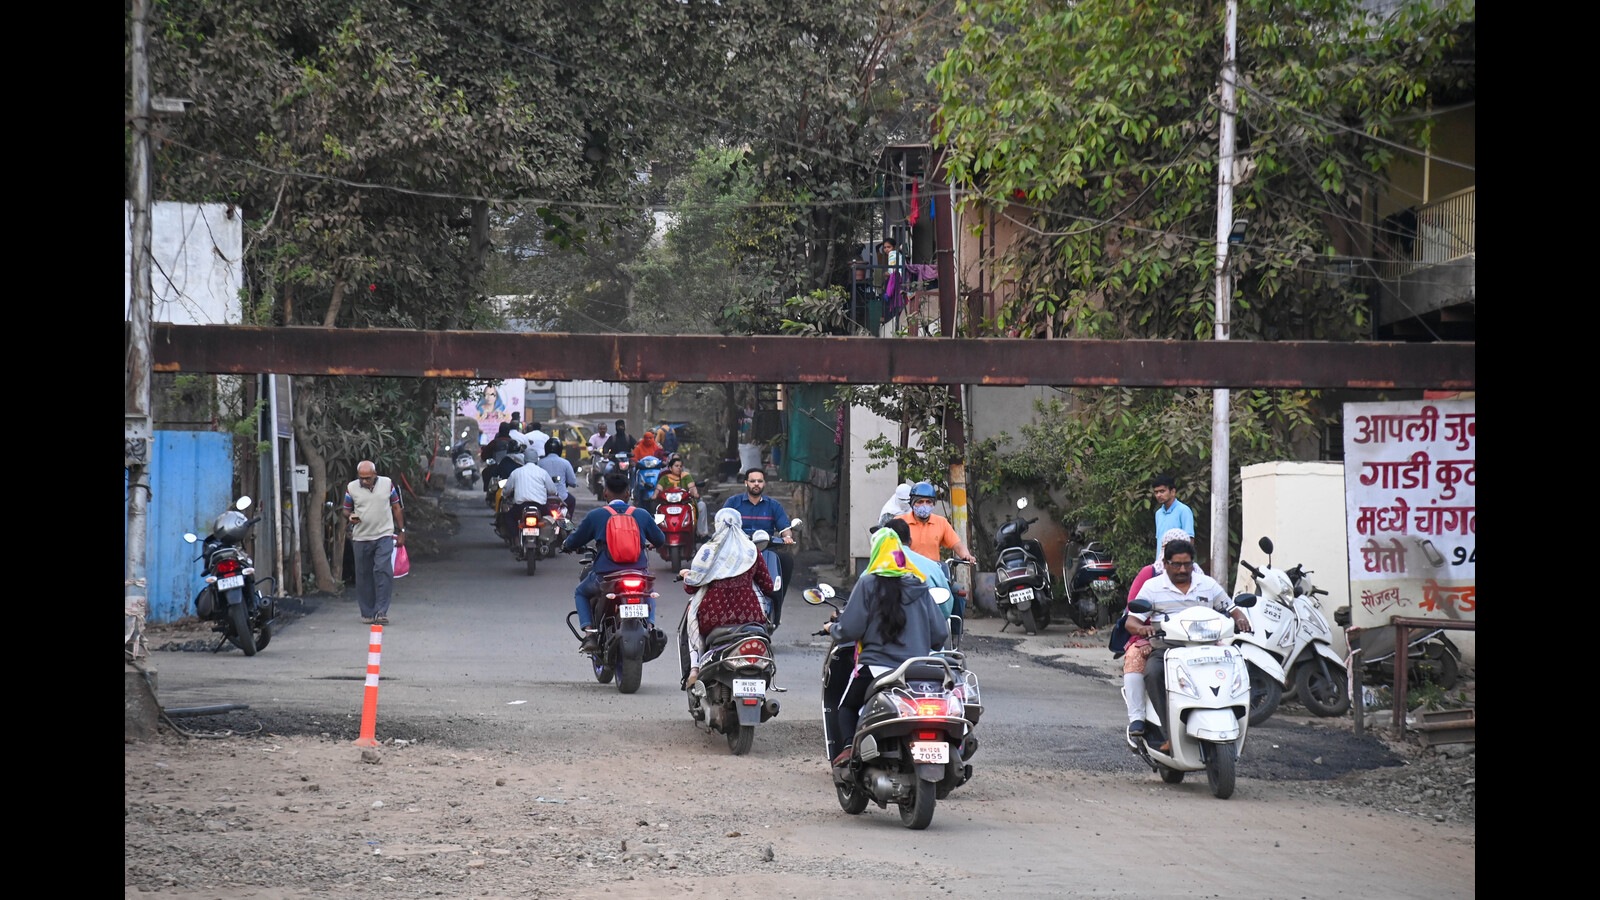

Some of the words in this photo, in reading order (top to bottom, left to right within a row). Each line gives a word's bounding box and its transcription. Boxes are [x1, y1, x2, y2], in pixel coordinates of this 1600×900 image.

[1353, 405, 1439, 444] आपली
[1359, 451, 1431, 489] गाडी
[1356, 497, 1410, 536] मध्ये
[1360, 538, 1407, 573] घेतो
